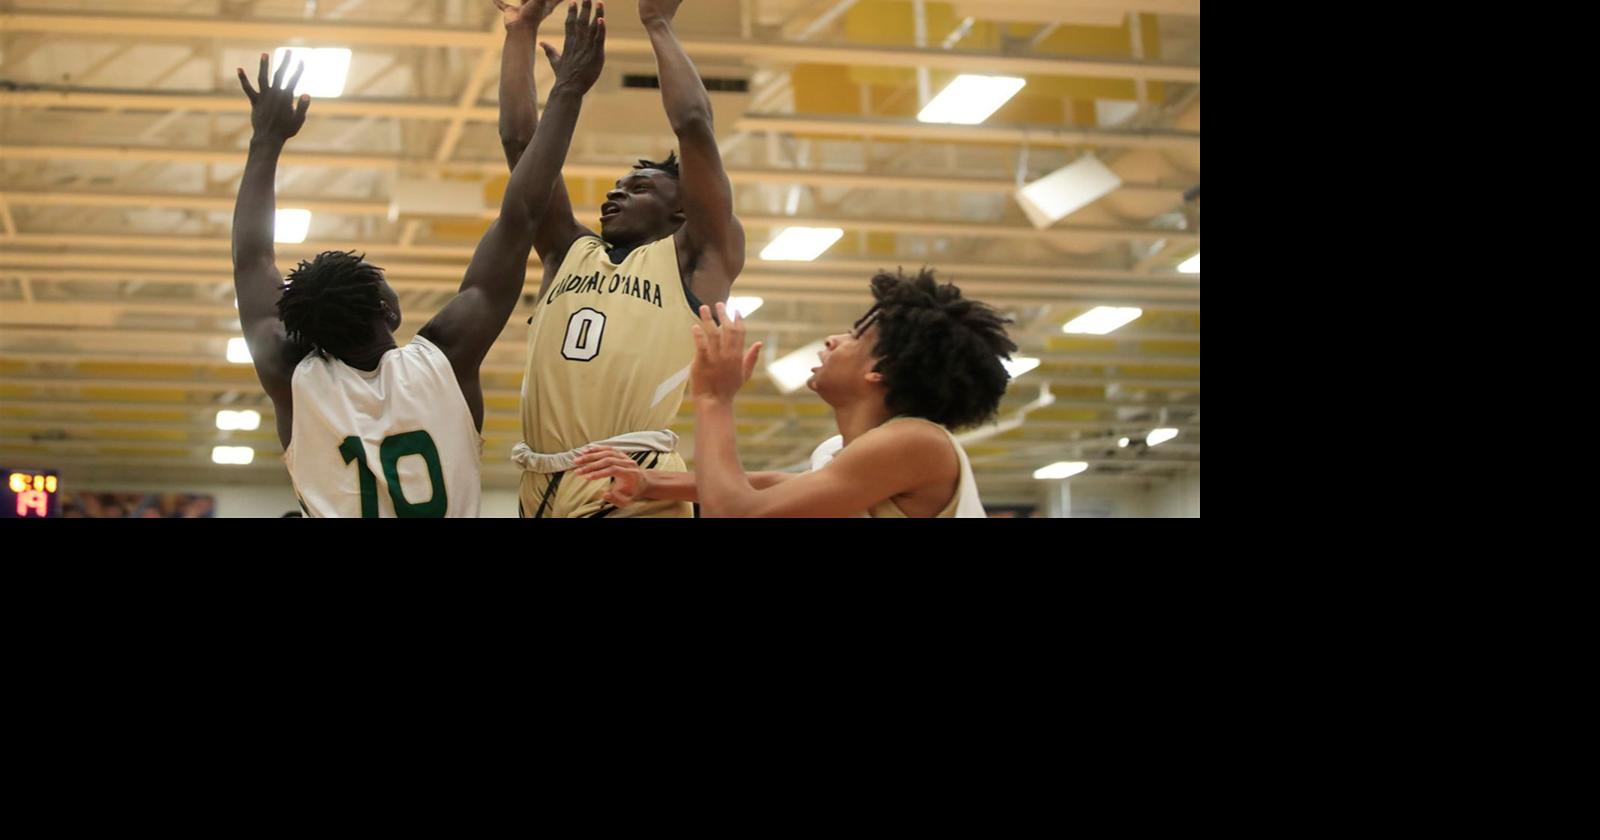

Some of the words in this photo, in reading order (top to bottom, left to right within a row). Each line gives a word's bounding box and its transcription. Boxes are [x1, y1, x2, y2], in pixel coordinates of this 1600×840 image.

[546, 271, 606, 305] CDIAL
[608, 273, 662, 308] O'HARA
[561, 307, 606, 361] 0
[338, 429, 448, 518] 10
